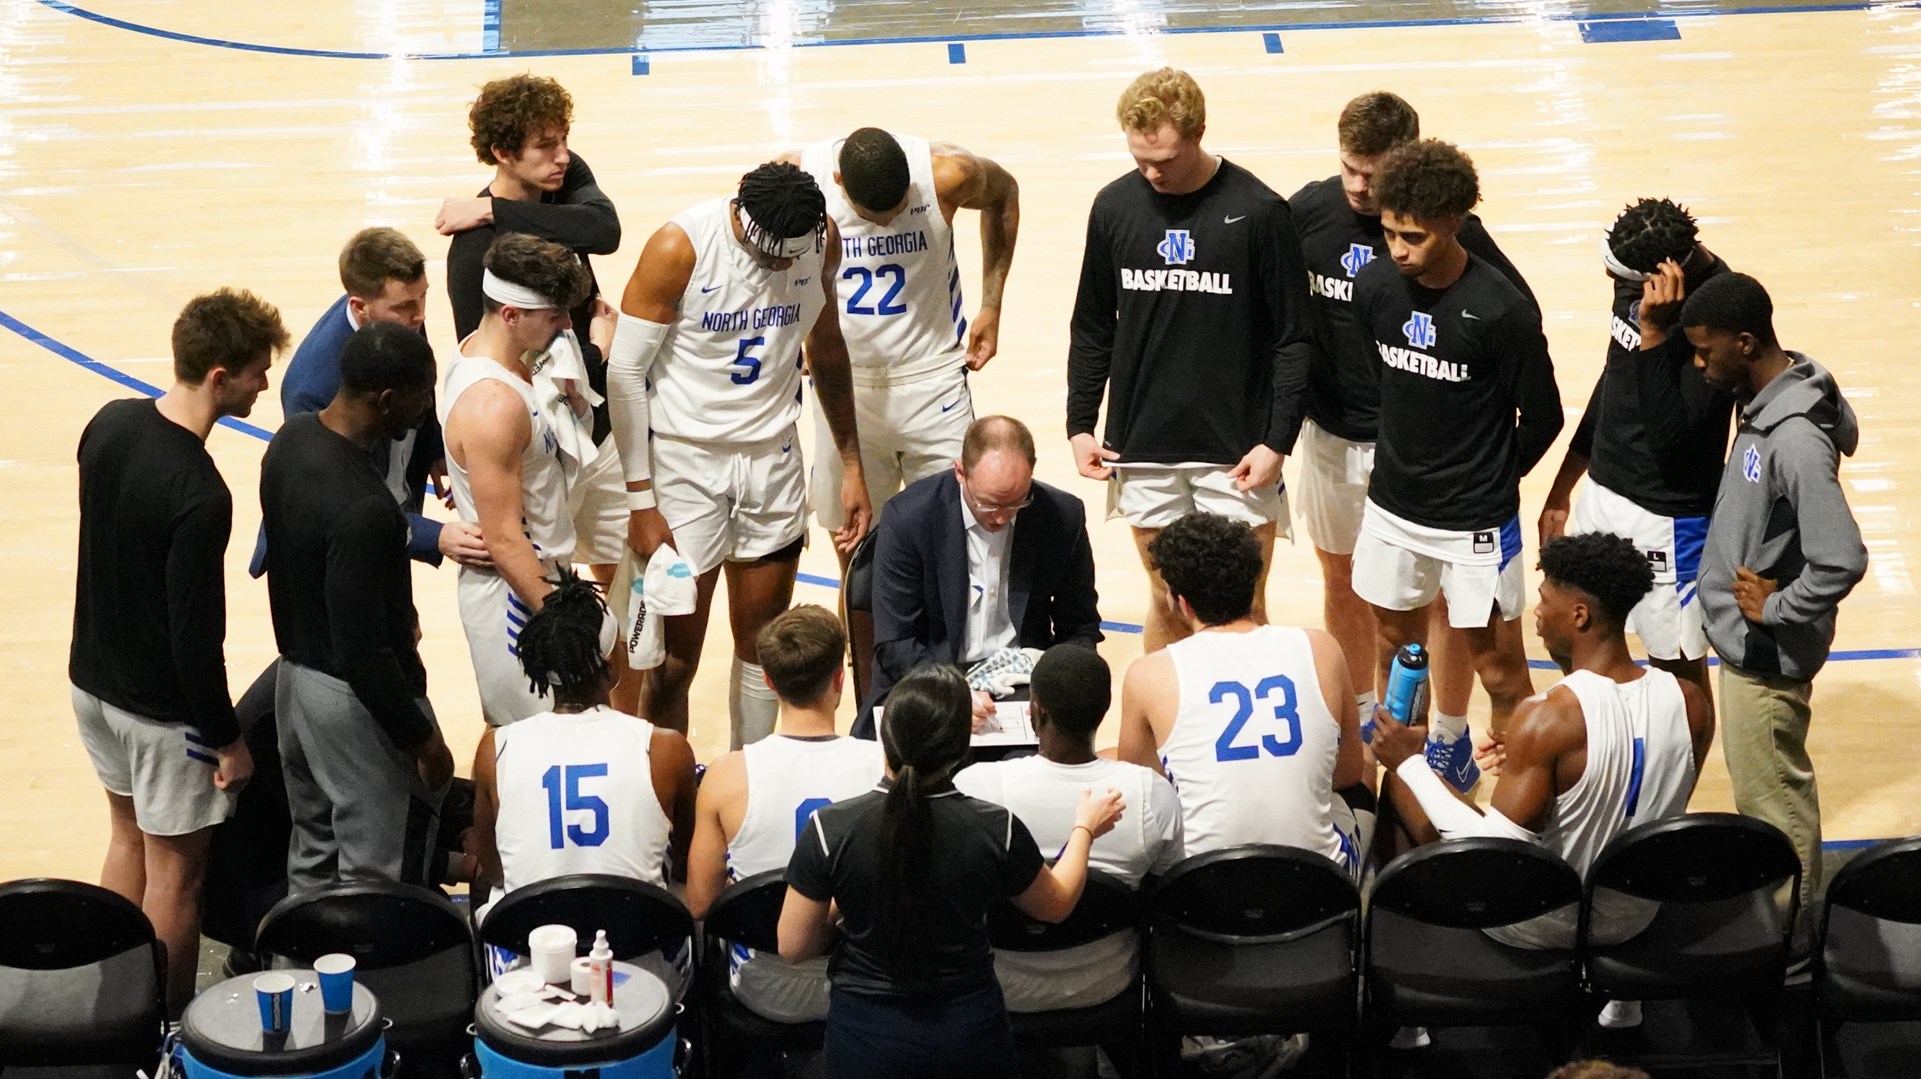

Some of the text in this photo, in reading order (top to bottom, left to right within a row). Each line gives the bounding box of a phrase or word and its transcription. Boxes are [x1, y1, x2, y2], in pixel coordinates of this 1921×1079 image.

[867, 230, 928, 257] GEORGIA
[842, 263, 907, 316] 22
[1120, 268, 1233, 294] BASKETBALL
[702, 303, 801, 332] NORTH GEORGIA
[730, 336, 765, 385] 5
[1208, 674, 1303, 762] 23
[542, 763, 610, 849] 15
